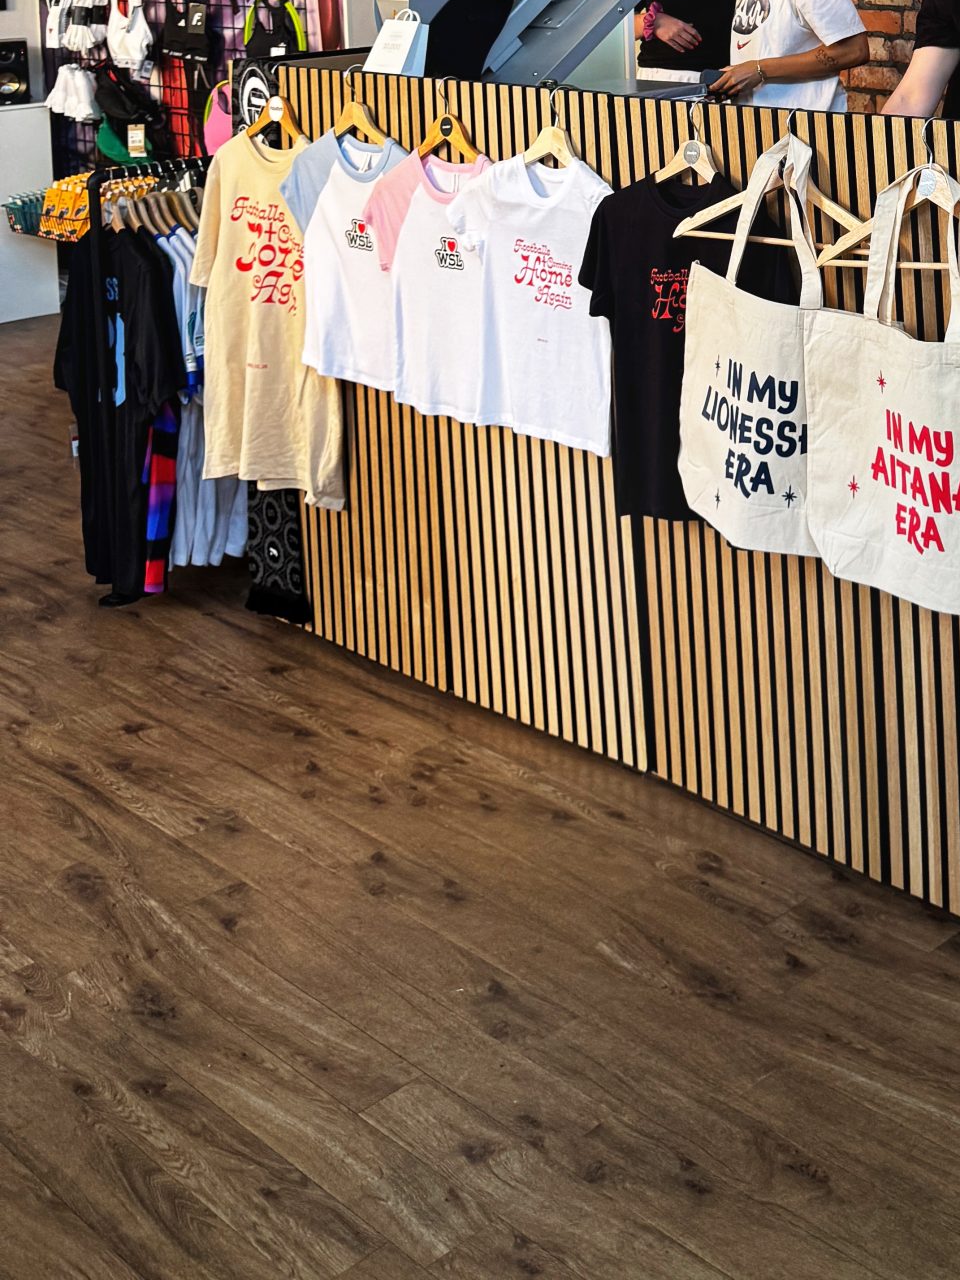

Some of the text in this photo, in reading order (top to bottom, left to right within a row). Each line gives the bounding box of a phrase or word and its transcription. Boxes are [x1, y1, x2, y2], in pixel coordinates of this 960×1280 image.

[348, 232, 372, 249] WSL
[437, 252, 462, 267] WSL
[514, 254, 573, 288] Home
[650, 268, 690, 285] Football
[727, 358, 743, 401] IN
[885, 409, 904, 452] IN
[725, 448, 775, 499] ERA
[895, 502, 945, 555] ERA
